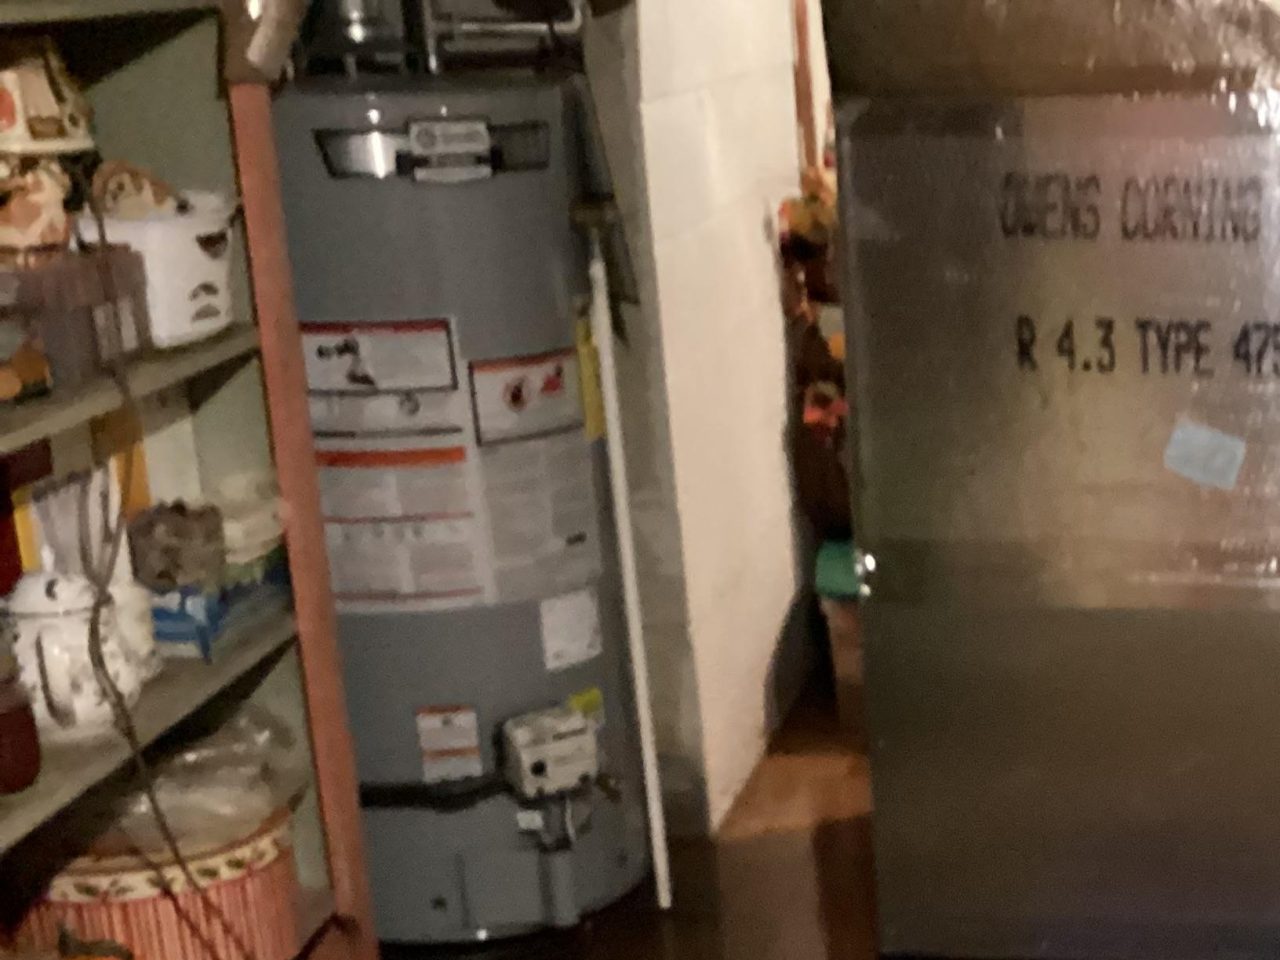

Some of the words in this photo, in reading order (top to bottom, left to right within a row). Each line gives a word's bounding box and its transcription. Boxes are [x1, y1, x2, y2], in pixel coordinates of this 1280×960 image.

[1120, 175, 1263, 241] CORNING
[1015, 314, 1038, 373] R
[1056, 317, 1116, 373] 4.3
[1135, 317, 1215, 378] TYPE
